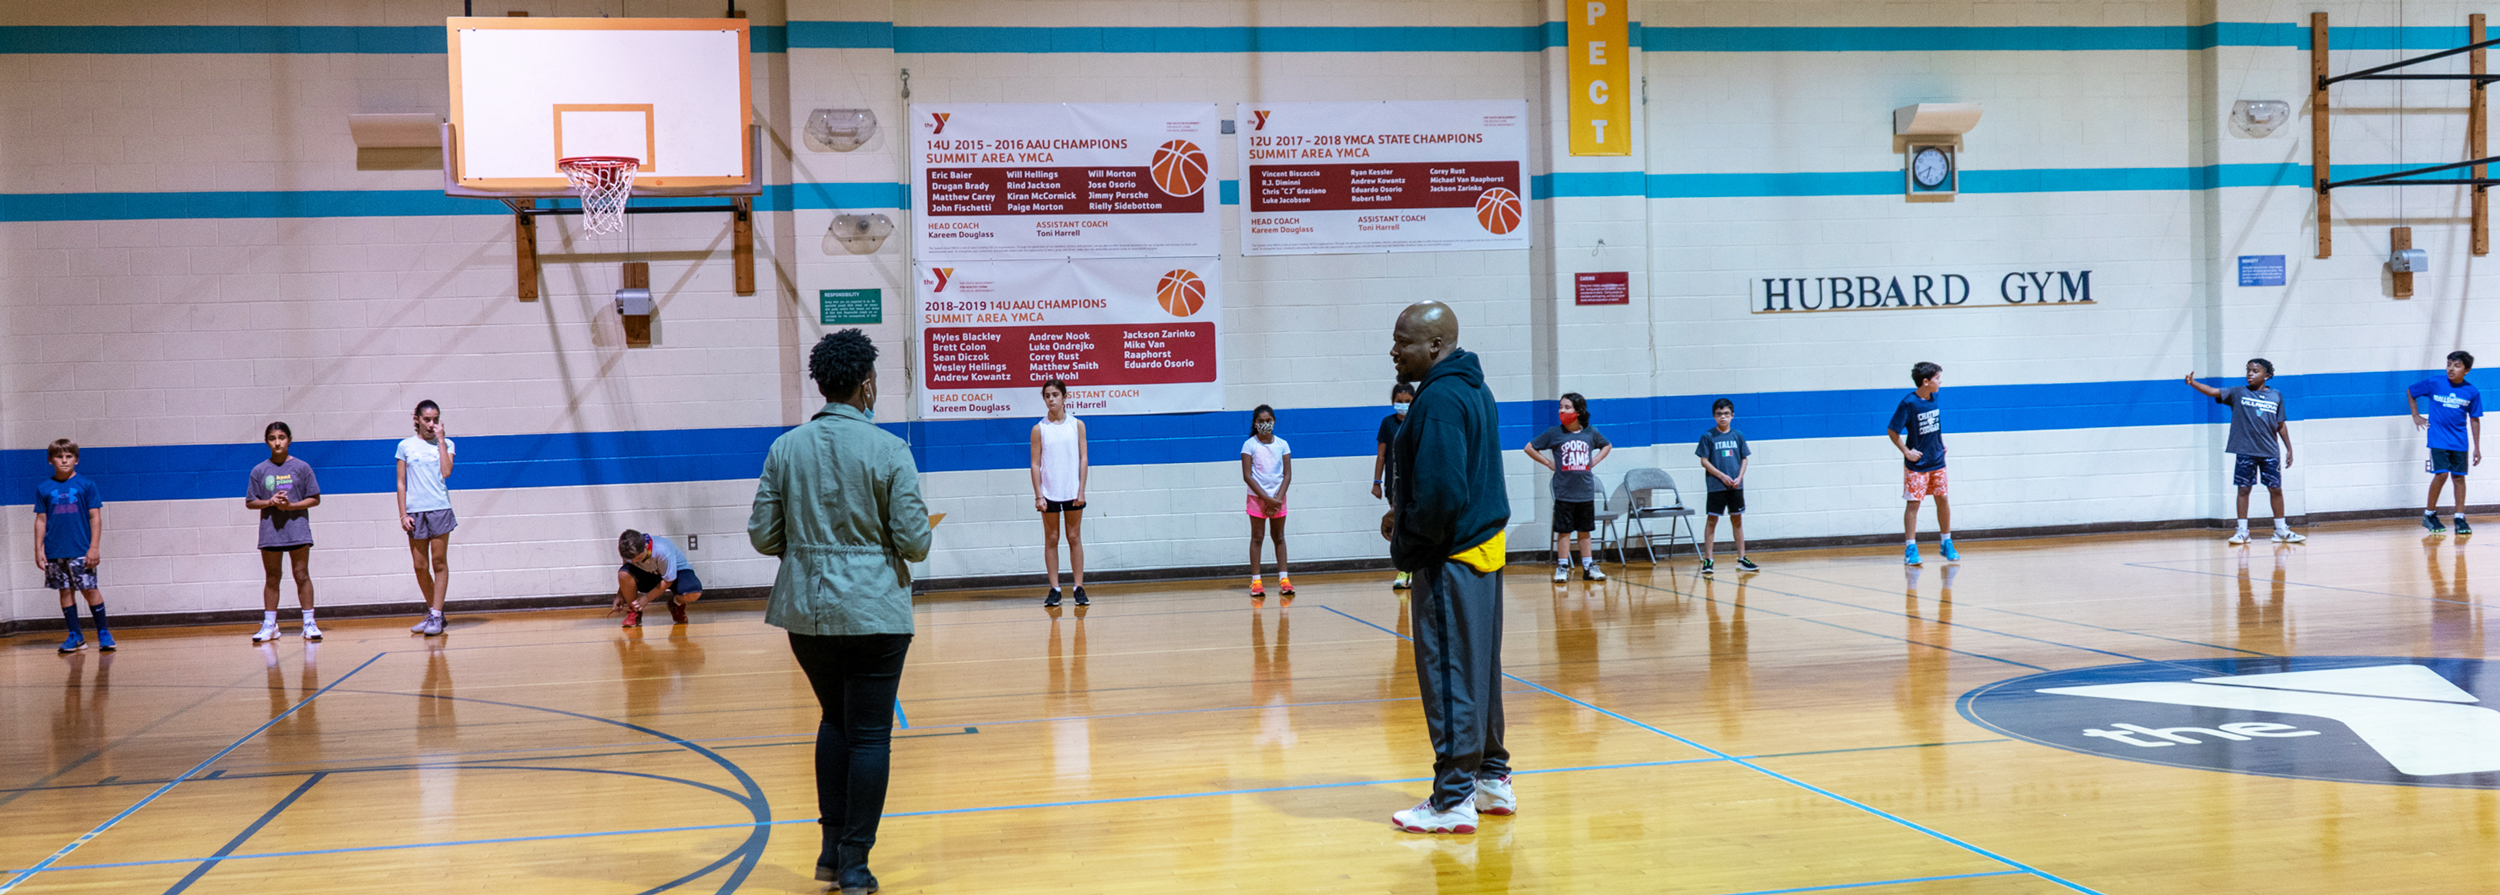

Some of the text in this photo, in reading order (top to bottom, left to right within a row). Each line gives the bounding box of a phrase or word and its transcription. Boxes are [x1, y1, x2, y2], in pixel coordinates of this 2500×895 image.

[927, 140, 949, 151] 14U
[955, 140, 983, 150] 2015
[996, 139, 1024, 150] 2016
[1026, 139, 1050, 149] AAU
[1054, 138, 1127, 149] CHAMPIONS
[1250, 136, 1271, 146] 12U
[1276, 136, 1302, 146] 2017
[1314, 135, 1341, 145] 2018
[1343, 135, 1374, 145] YMCA
[1378, 134, 1410, 144] STATE
[1413, 134, 1482, 144] CHAMPIONS
[927, 153, 1054, 163] SUMMIT AREA YMCA
[1249, 148, 1369, 159] SUMMIT AREA YMCA
[932, 171, 972, 179] Eric Baier
[1007, 170, 1058, 180] Will Hellings
[1262, 170, 1287, 178] Vincent
[1351, 168, 1393, 178] Ryan Kessler
[1430, 168, 1448, 176] Corey
[1108, 180, 1136, 188] Osorio
[1430, 176, 1455, 184] Michael
[1470, 176, 1504, 184] Raaphorst
[932, 182, 989, 192] Drugan Brady
[1007, 181, 1060, 189] Rind Jackson
[1430, 185, 1456, 193] Jackson
[1297, 187, 1326, 195] Graziano
[1352, 186, 1378, 194] Eduardo
[932, 193, 995, 203] Matthew Carey
[1007, 192, 1076, 200] Kiran McCormick
[1088, 191, 1148, 200] Jimmy Persche
[932, 203, 991, 212] John Fischetti
[1008, 203, 1063, 212] Paige Morton
[1090, 201, 1162, 212] Rielly Sidebottom
[1281, 226, 1313, 234] Douglass
[959, 231, 994, 239] Douglass
[1762, 270, 2093, 311] HUBBARD GYM
[990, 301, 1010, 311] 14U
[1013, 300, 1035, 310] AAU
[1037, 299, 1106, 310] CHAMPIONS
[925, 312, 1044, 323] SUMMIT AREA YMCA
[933, 332, 1001, 343] Myles Blackley
[1029, 332, 1089, 340] Andrew Nook
[1124, 330, 1195, 339] Jackson Zarinko
[934, 343, 957, 351] Brett
[1029, 342, 1094, 351] Luke Ondrejko
[1124, 341, 1145, 349] Mike
[933, 353, 989, 361] Sean Diczok
[1030, 352, 1079, 362] Corey Rust
[1124, 351, 1171, 359] Raaphorst
[934, 363, 1006, 372] Wesley Hellings
[1030, 362, 1099, 370] Matthew Smith
[1164, 360, 1194, 368] Osorio
[934, 372, 1010, 381] Andrew Kowantz
[1030, 372, 1078, 381] Chris Wohl
[961, 393, 993, 401] COACH
[933, 403, 1010, 412] Kareem Douglass
[1076, 400, 1106, 408] Harrell
[1561, 440, 1589, 455] SPORTS
[1715, 440, 1738, 450] ITALIA
[1562, 451, 1590, 466] CAMP
[2083, 722, 2321, 748] the
